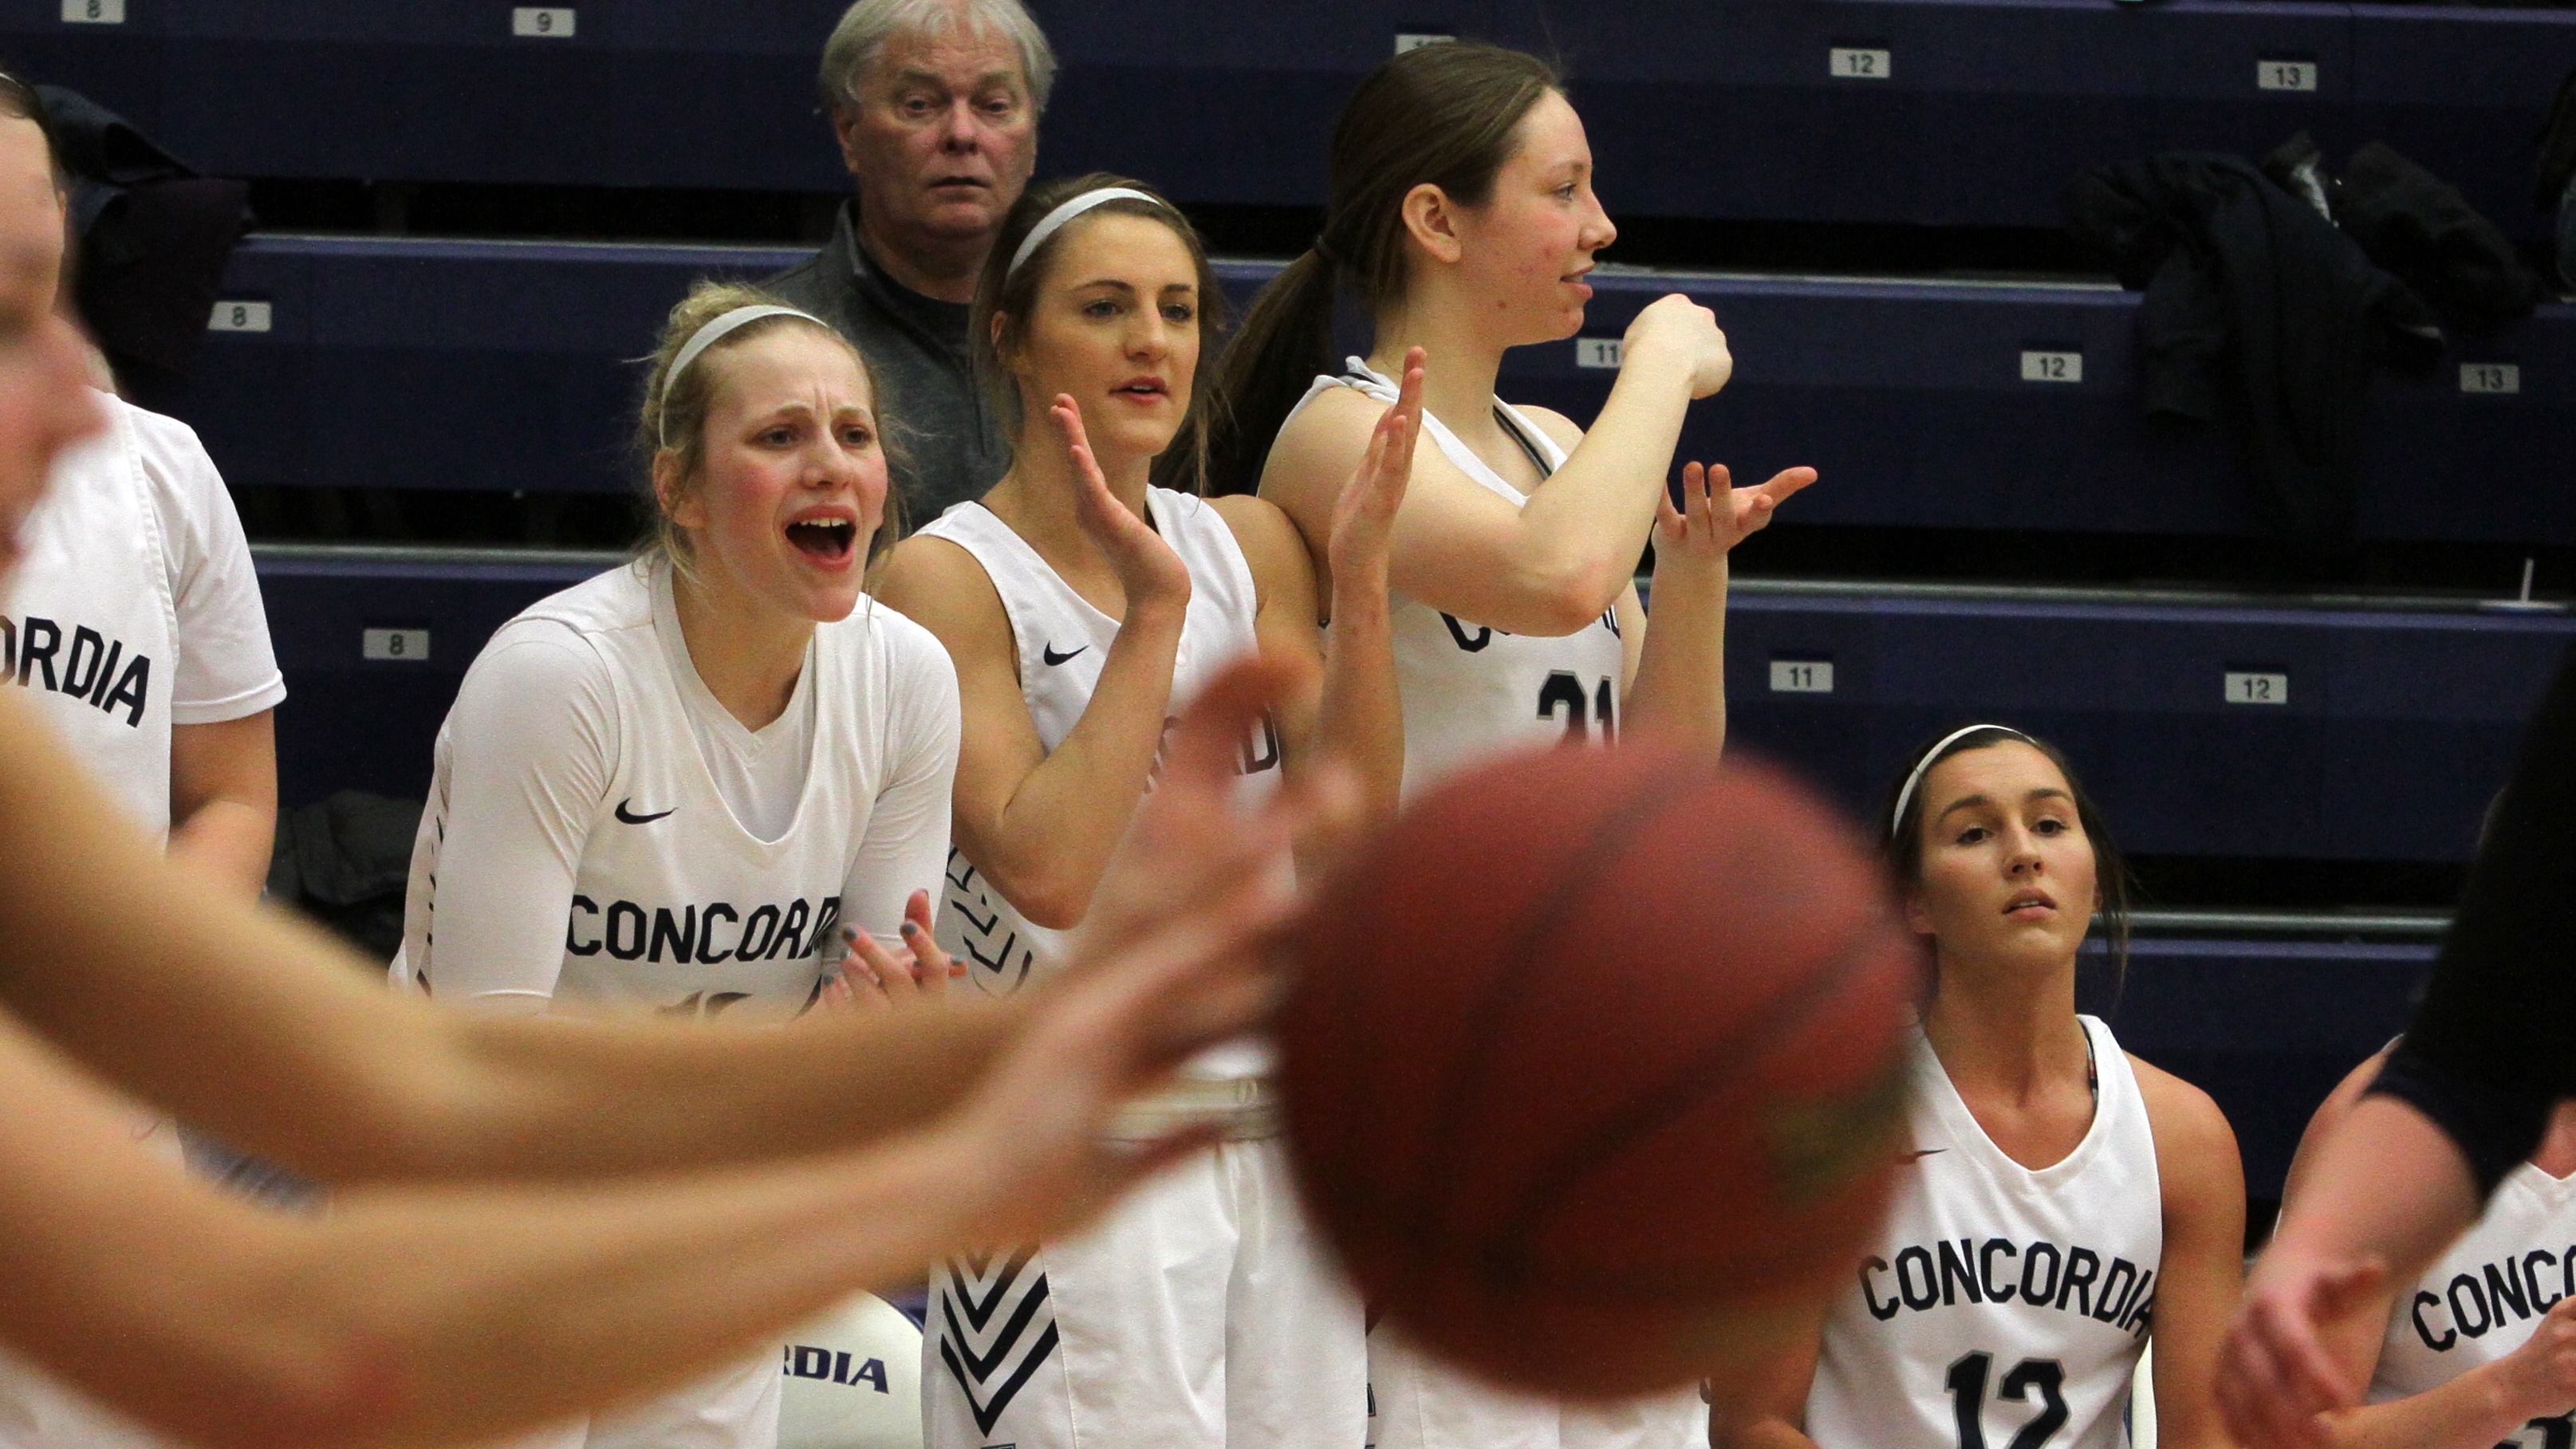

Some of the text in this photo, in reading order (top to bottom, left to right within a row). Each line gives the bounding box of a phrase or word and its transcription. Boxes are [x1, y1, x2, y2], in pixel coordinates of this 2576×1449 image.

[87, 0, 100, 18] 8
[537, 11, 552, 32] 9
[1849, 53, 1874, 73] 12
[2276, 66, 2301, 86] 13
[232, 306, 246, 327] 8
[1597, 343, 1617, 363] 11
[2040, 356, 2065, 377] 12
[2478, 368, 2503, 389] 13
[389, 634, 404, 656] 8
[1790, 667, 1811, 687] 11
[2244, 678, 2270, 699] 12
[2412, 1245, 2576, 1353] CONC
[1944, 1349, 2072, 1449] 12
